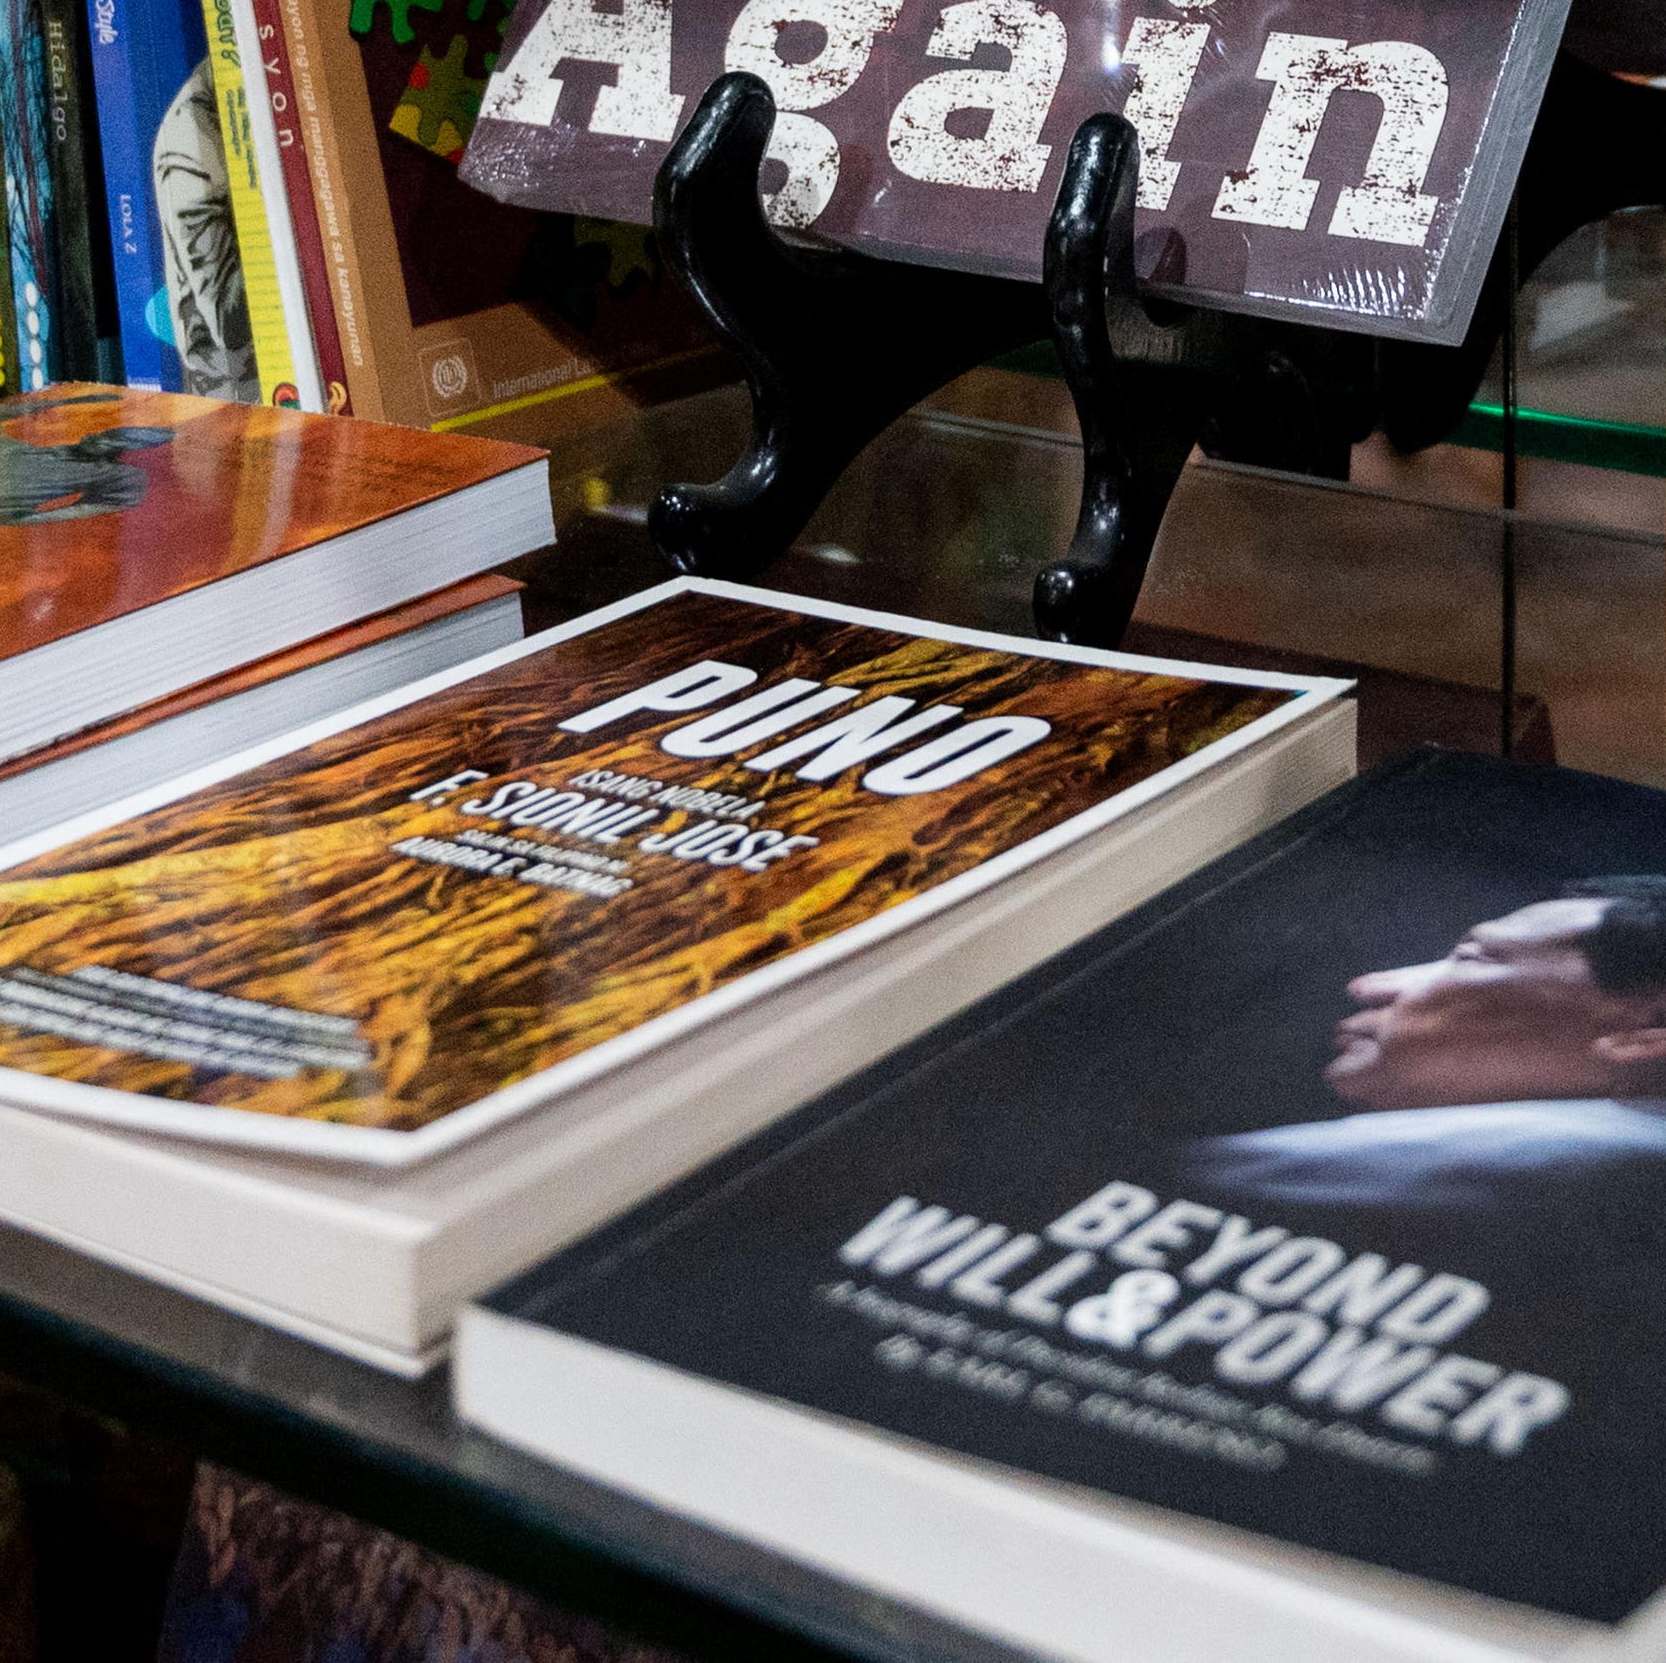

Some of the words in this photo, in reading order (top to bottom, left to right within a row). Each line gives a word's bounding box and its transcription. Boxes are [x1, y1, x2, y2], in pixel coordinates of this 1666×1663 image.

[43, 19, 73, 141] Hidalgo
[557, 659, 1052, 797] PUNO
[410, 769, 489, 805] F.
[462, 781, 659, 844] SIONIL
[638, 819, 820, 872] JOSE
[568, 768, 662, 802] ISANG
[650, 784, 767, 821] NOBELA
[1044, 1179, 1490, 1342] BEYOND
